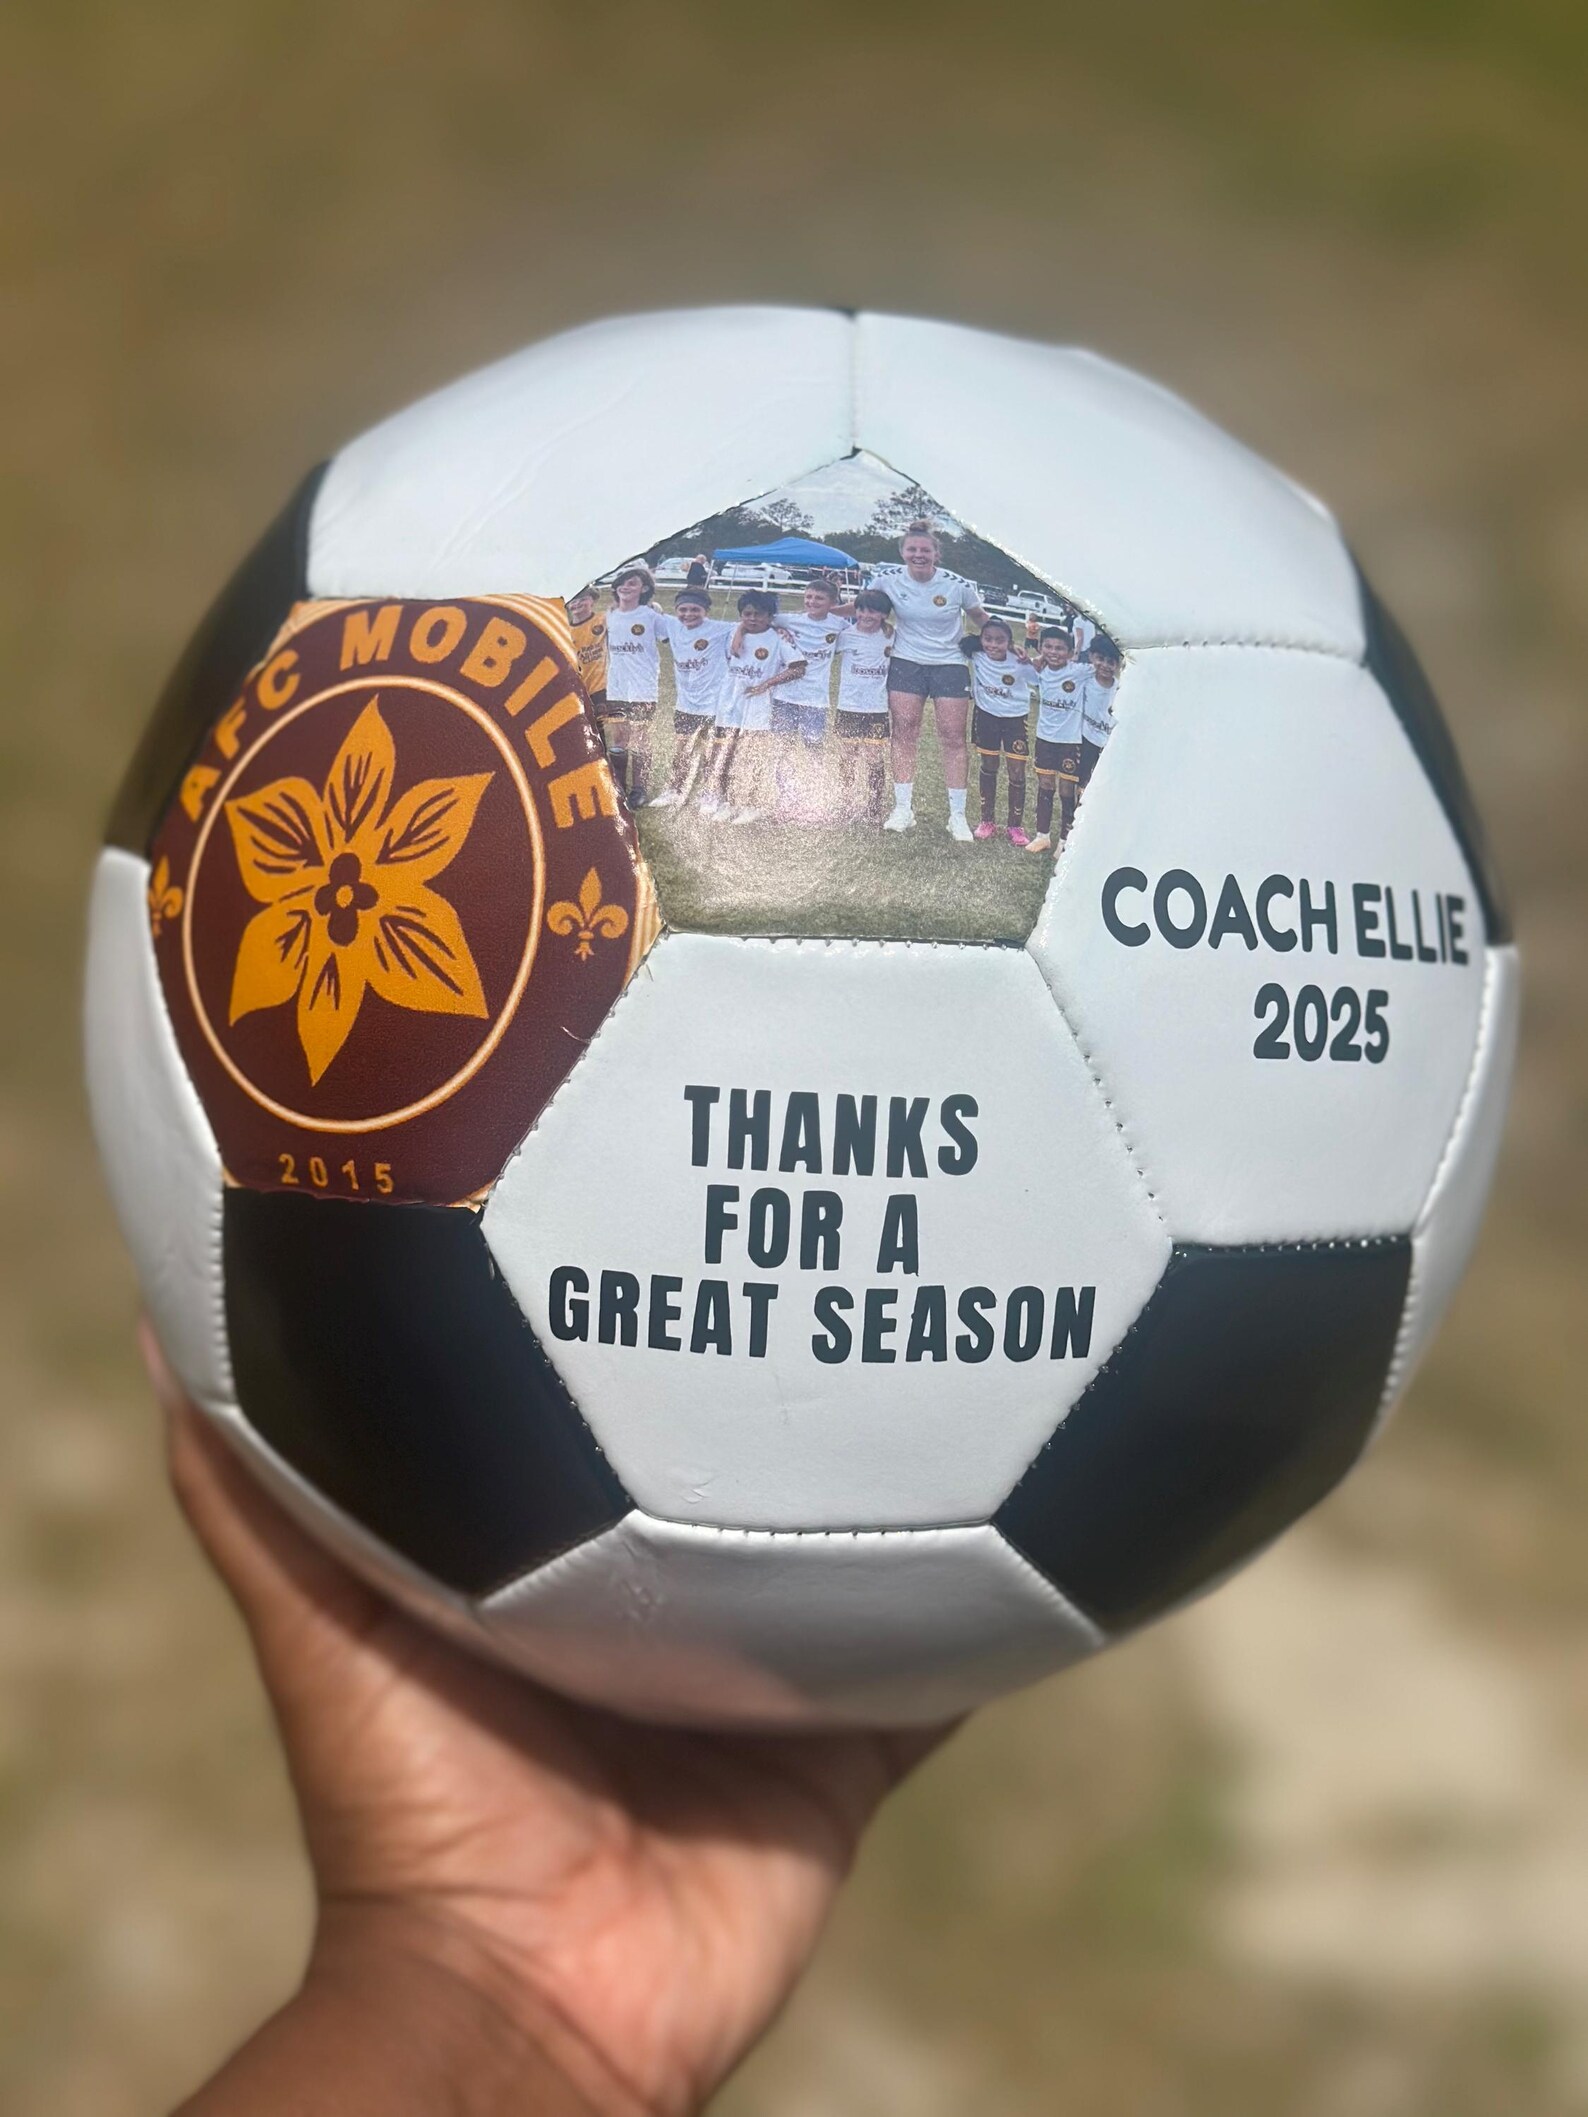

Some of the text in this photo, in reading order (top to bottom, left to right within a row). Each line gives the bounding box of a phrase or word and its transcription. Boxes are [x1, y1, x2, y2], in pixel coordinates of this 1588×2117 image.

[181, 605, 619, 829] AFC MOBILE
[1101, 866, 1469, 966] COACH ELLIE
[1253, 982, 1390, 1064] 2025
[278, 1153, 394, 1195] 2015
[684, 1085, 979, 1178] THANKS
[704, 1184, 919, 1276] FOR A
[549, 1265, 1097, 1364] GREAT SEASON
